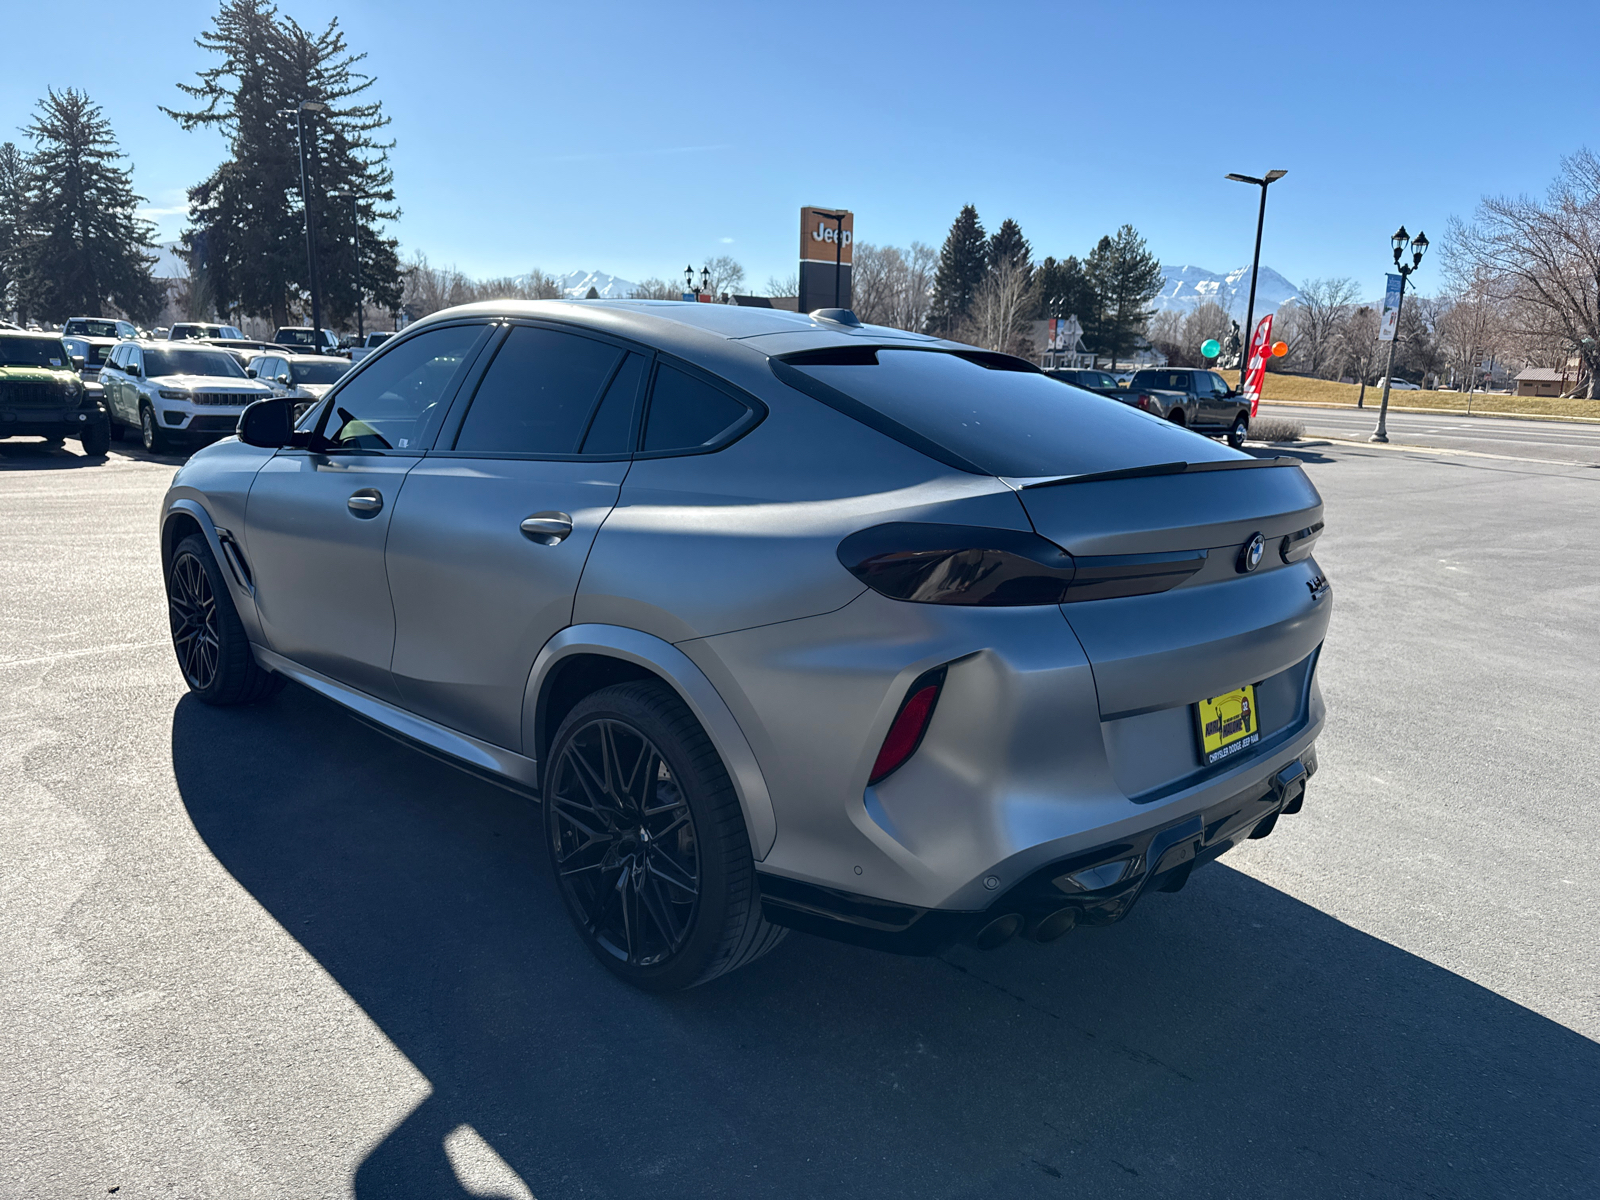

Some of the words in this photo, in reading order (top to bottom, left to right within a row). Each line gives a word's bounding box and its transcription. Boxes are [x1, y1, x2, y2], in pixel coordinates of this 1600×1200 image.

[813, 222, 852, 248] Jeep
[1243, 701, 1248, 711] 32
[1209, 747, 1229, 763] CHRYSLER
[1229, 741, 1241, 754] DODGE
[1242, 736, 1250, 748] JEEP
[1251, 733, 1259, 743] RAM
